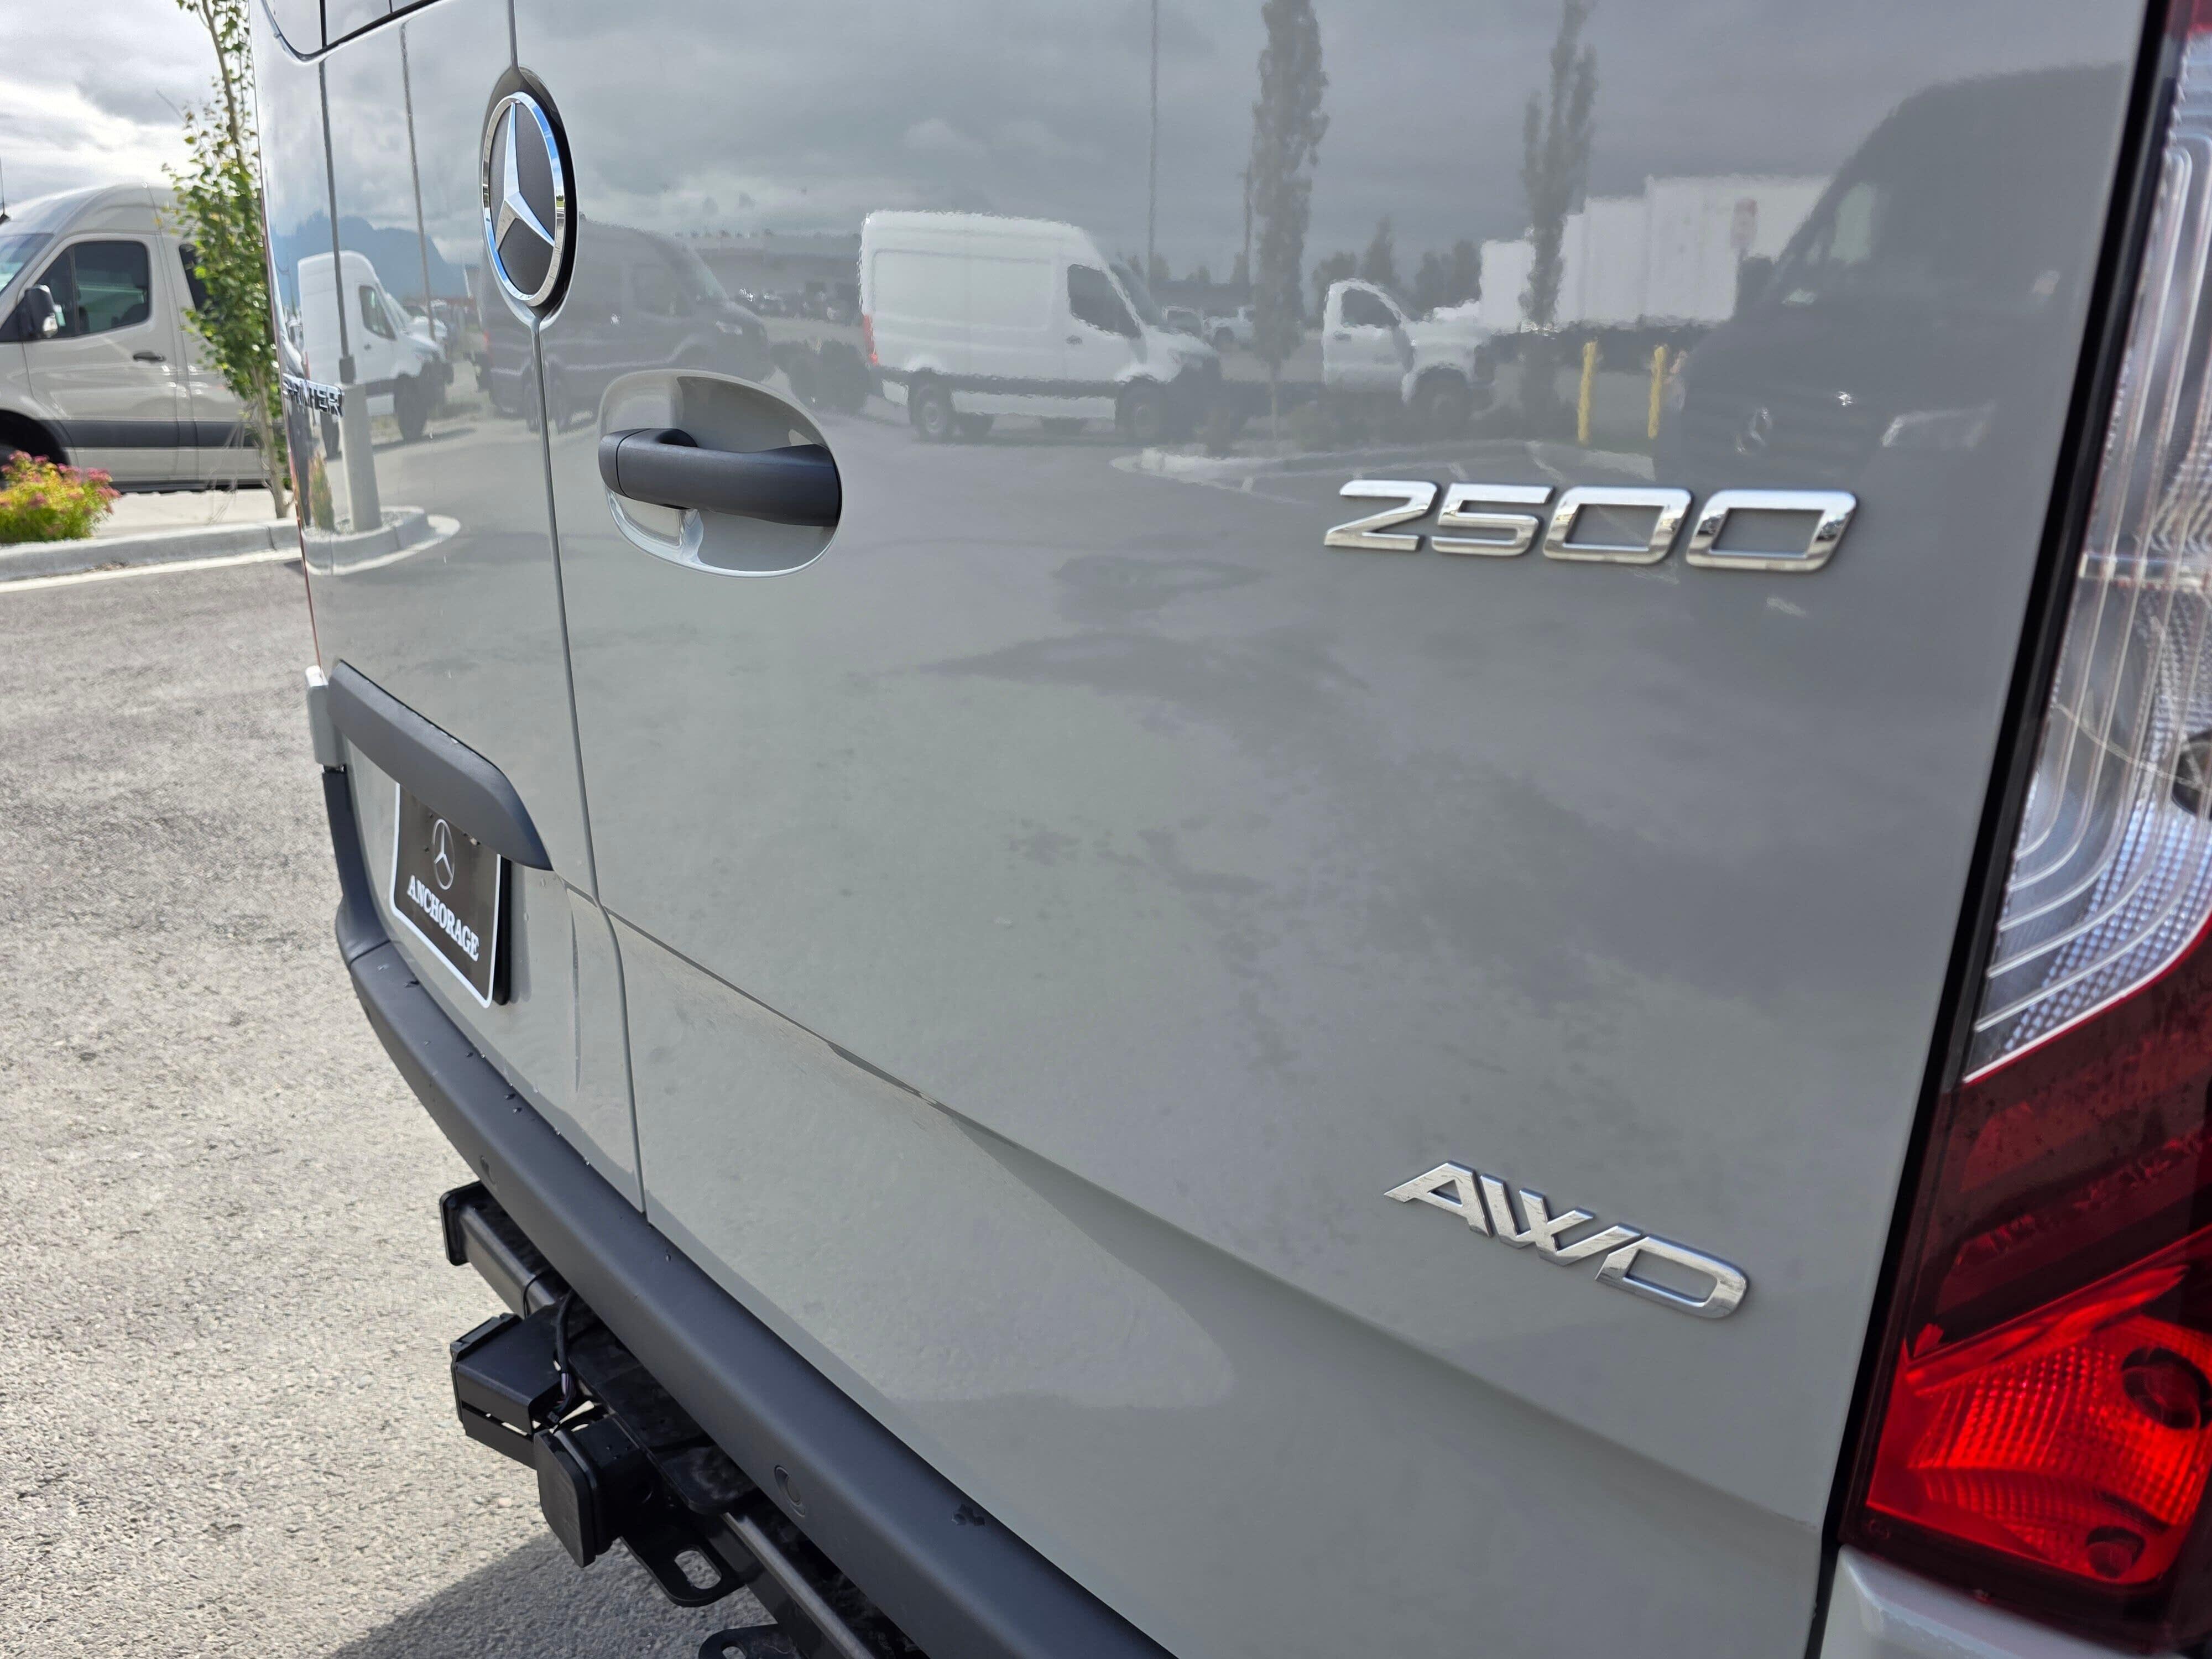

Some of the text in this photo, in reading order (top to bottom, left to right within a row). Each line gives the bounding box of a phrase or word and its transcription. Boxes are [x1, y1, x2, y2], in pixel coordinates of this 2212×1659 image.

[1324, 479, 1858, 571] 2500
[406, 874, 479, 962] ANCHORAGE
[1384, 1161, 1747, 1319] AWD
